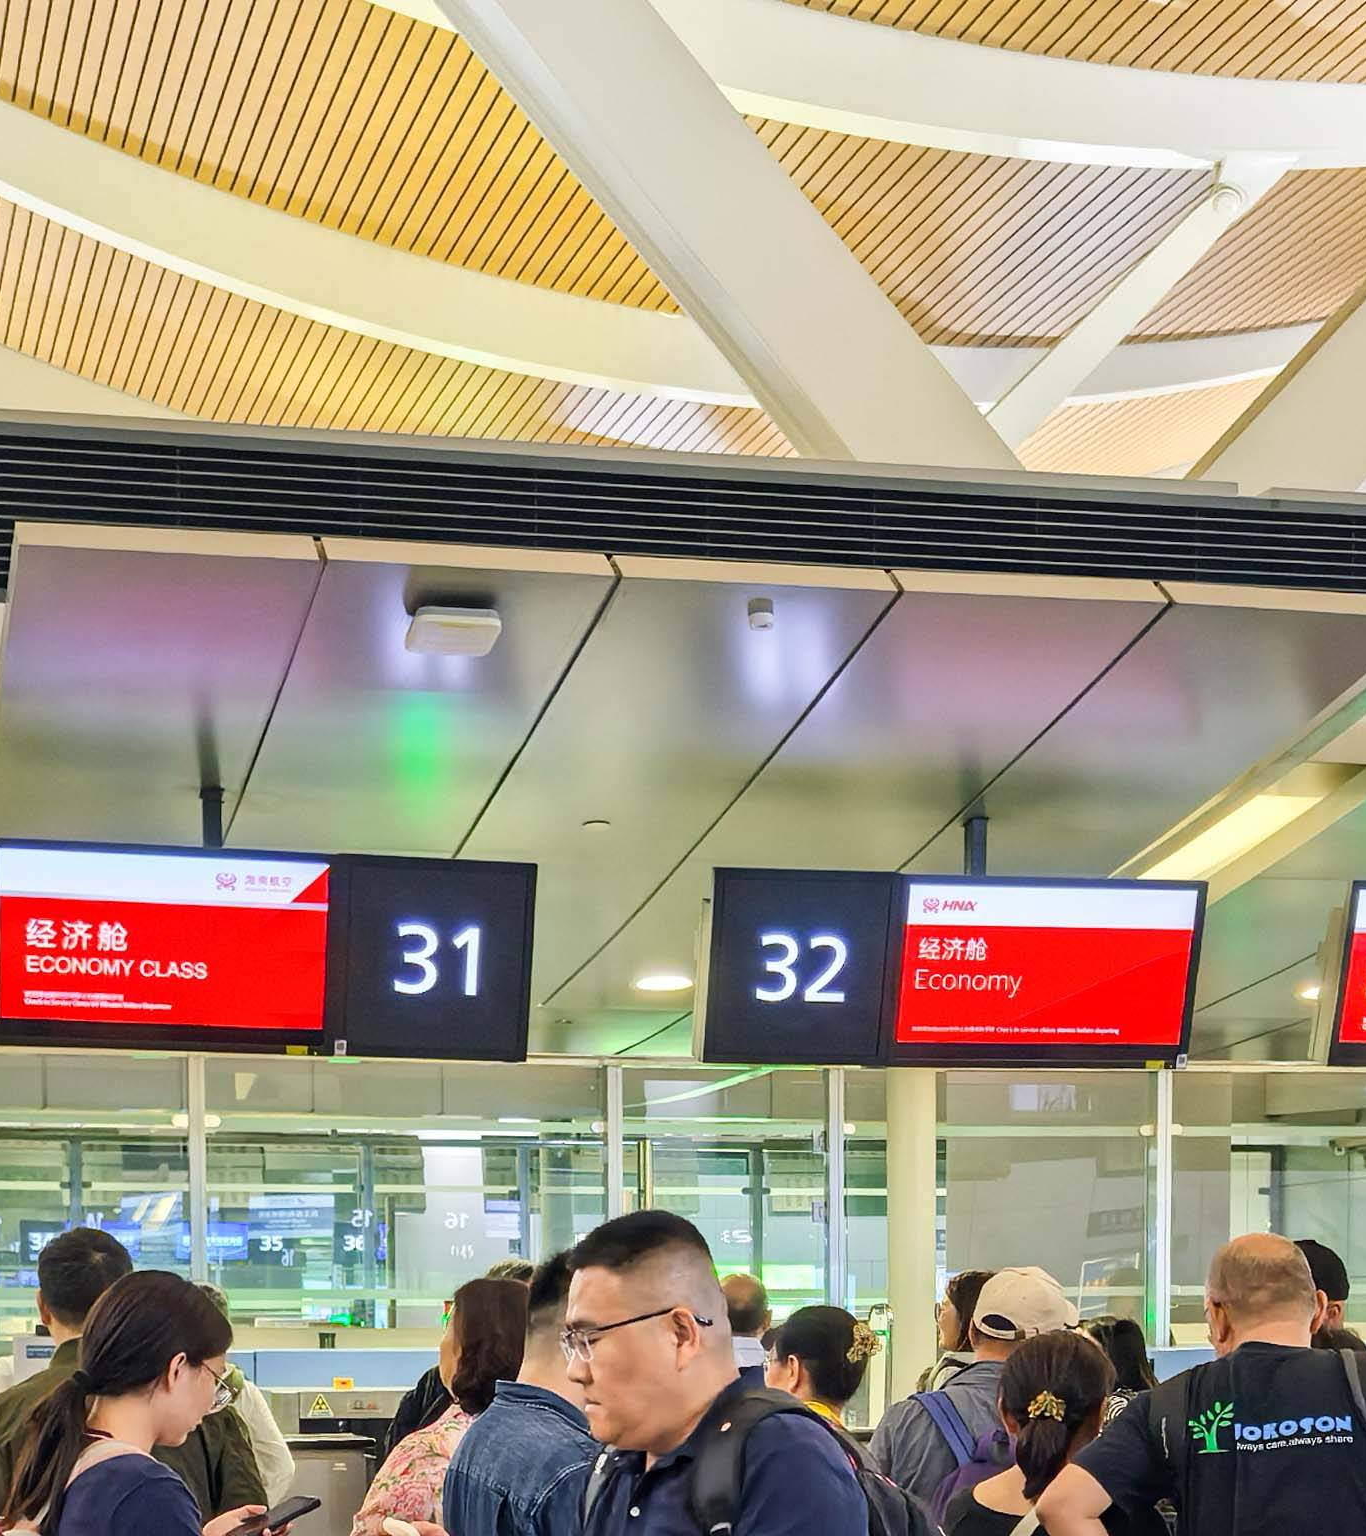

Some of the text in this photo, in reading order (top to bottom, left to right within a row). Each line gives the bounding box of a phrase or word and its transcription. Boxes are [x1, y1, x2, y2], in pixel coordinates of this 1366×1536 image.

[25, 918, 129, 952] 经济舱
[918, 936, 988, 963] 经济舱
[25, 955, 208, 981] ECONOMY CLASS
[393, 924, 482, 997] 31
[755, 935, 848, 1003] 32
[915, 968, 1023, 998] Economy
[259, 1235, 284, 1252] 35
